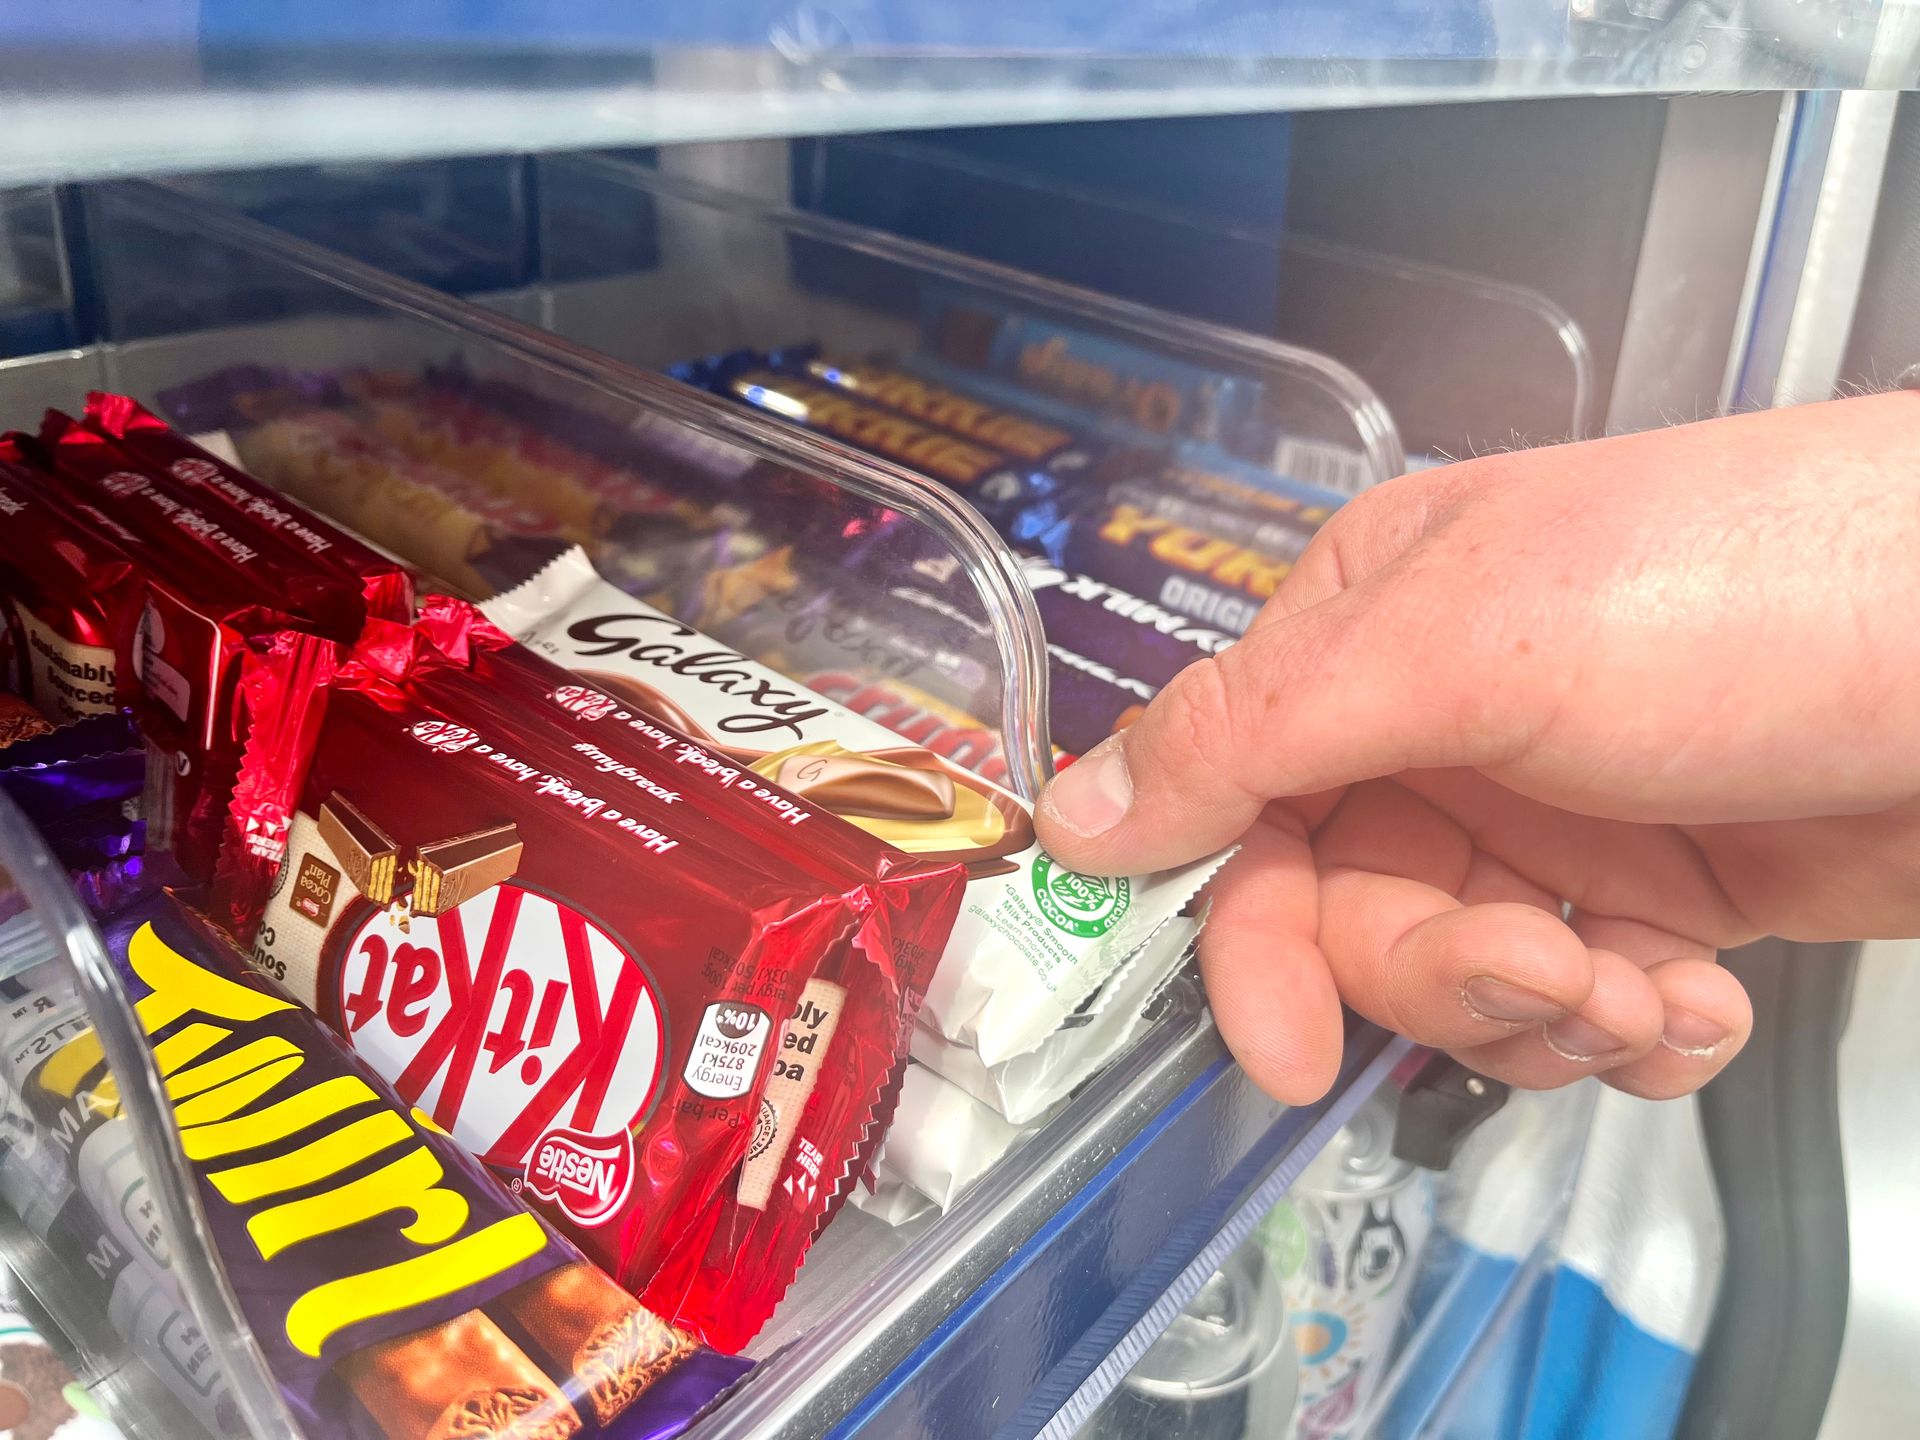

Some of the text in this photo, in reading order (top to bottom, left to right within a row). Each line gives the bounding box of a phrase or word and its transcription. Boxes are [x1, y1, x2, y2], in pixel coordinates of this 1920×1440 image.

[220, 537, 259, 564] Have
[295, 526, 333, 555] Have
[567, 614, 829, 741] Galaxy
[614, 708, 629, 720] a
[472, 743, 489, 755] a
[628, 719, 677, 752] have
[488, 752, 537, 783] have
[572, 741, 684, 806] #mybreak
[743, 779, 756, 791] a
[603, 807, 620, 821] a
[754, 787, 812, 827] Have
[246, 833, 285, 850] HERE
[618, 816, 681, 856] Have
[300, 875, 332, 906] Cocoa
[1066, 873, 1099, 910] 100%
[1001, 900, 1062, 964] Milk Products
[1043, 927, 1078, 965] Smooth
[1023, 935, 1045, 960] more
[1044, 959, 1055, 971] at
[343, 885, 637, 1158] KitKat
[699, 1034, 758, 1057] 209kcal
[702, 1052, 745, 1070] 875kJ
[692, 1066, 743, 1091] Energy
[128, 920, 549, 1359] Twirl
[798, 1137, 824, 1167] TEAR
[795, 1151, 822, 1180] HERE
